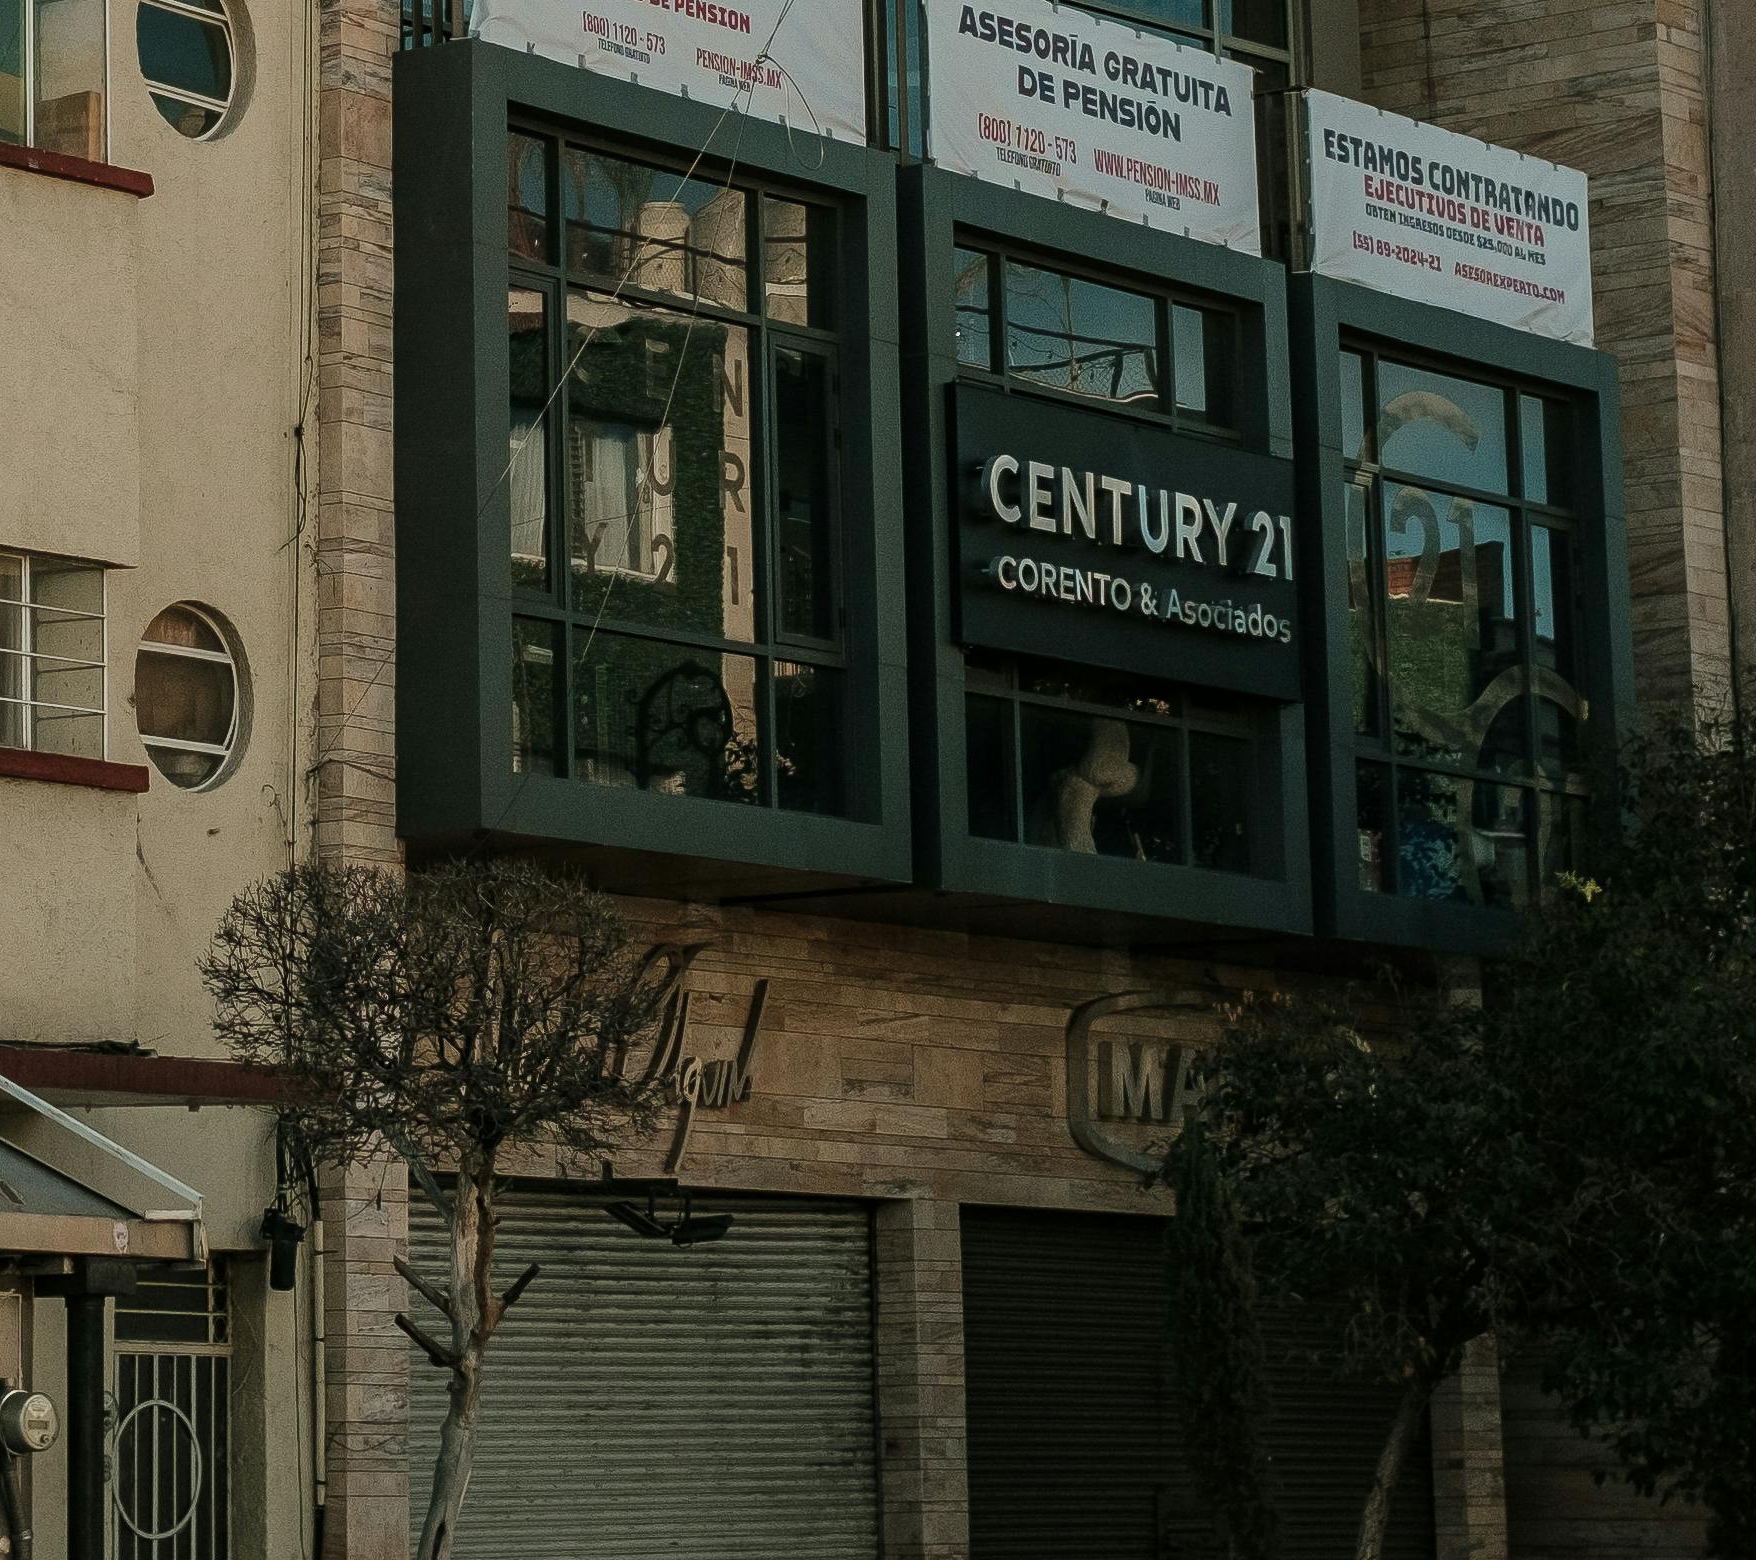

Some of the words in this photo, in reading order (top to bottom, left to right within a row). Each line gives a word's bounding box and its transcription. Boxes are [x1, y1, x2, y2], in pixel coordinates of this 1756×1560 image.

[582, 10, 610, 33] (800)
[612, 22, 638, 47] 1120
[646, 32, 666, 55] 573
[957, 3, 1098, 75] ASESORÍA
[1102, 49, 1233, 117] GRATUITA
[977, 112, 1012, 147] (800)
[1015, 124, 1046, 155] 1120
[1054, 135, 1077, 165] 573
[1017, 64, 1056, 104] DE
[1062, 80, 1182, 142] PENSIÓN
[1093, 147, 1221, 207] WWW.PENSION-IMSS.MX
[1323, 128, 1424, 185] ESTAMOS
[1428, 161, 1579, 231] CONTRATANDO
[1363, 174, 1467, 225] EJECUTIVOS
[1470, 205, 1491, 231] DE
[1493, 212, 1545, 248] VENTA
[1446, 227, 1475, 246] DESDE
[987, 454, 1238, 567] CENTURY
[1250, 510, 1294, 581] 21
[995, 555, 1132, 612] CORENTO
[1140, 582, 1159, 617] &
[1164, 588, 1292, 644] Asociados
